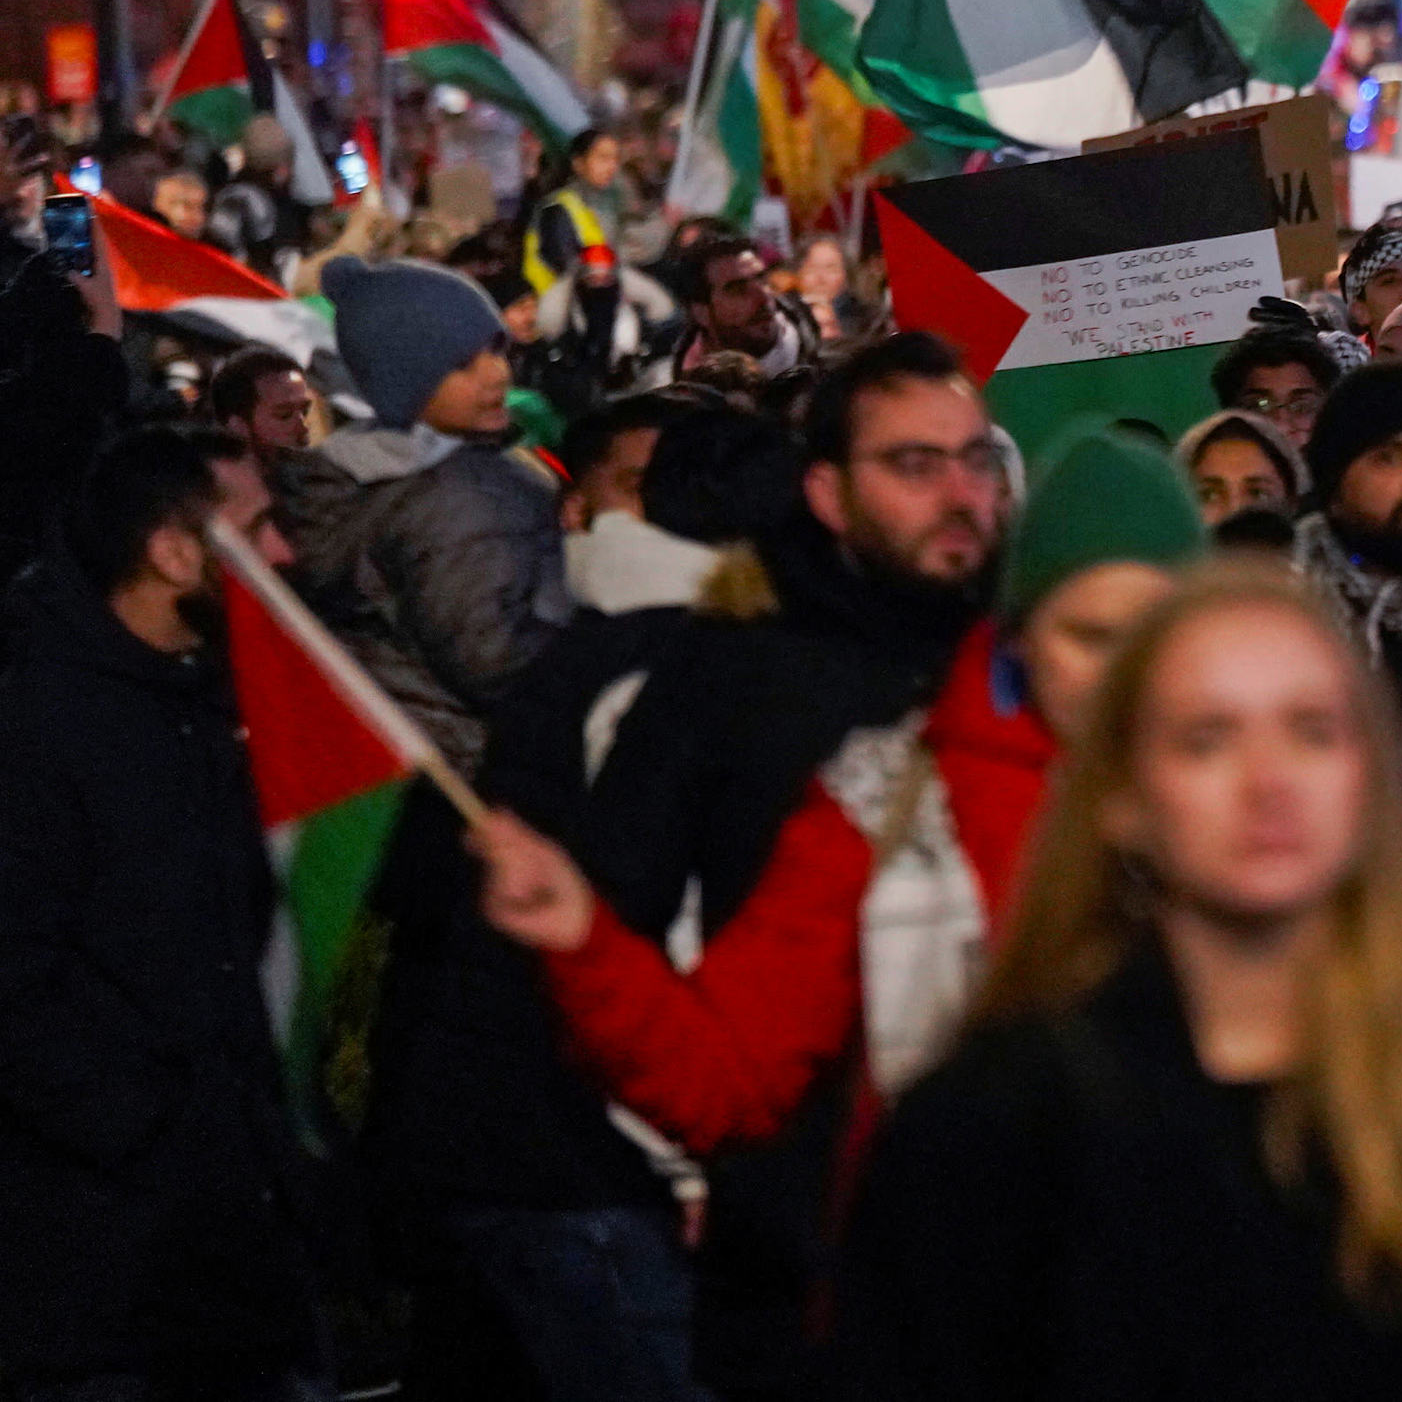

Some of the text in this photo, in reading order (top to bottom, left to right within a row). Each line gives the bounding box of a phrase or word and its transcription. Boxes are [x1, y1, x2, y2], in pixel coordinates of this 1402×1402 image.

[1041, 246, 1198, 286] NO TO GENOCIDE
[1042, 288, 1072, 304] NO
[1082, 281, 1108, 296] TO
[1175, 257, 1254, 280] CLEANSING
[1043, 279, 1262, 325] NO TO KILLING CHILDREN
[1062, 327, 1101, 347] WE
[1096, 330, 1197, 356] PALESTINE
